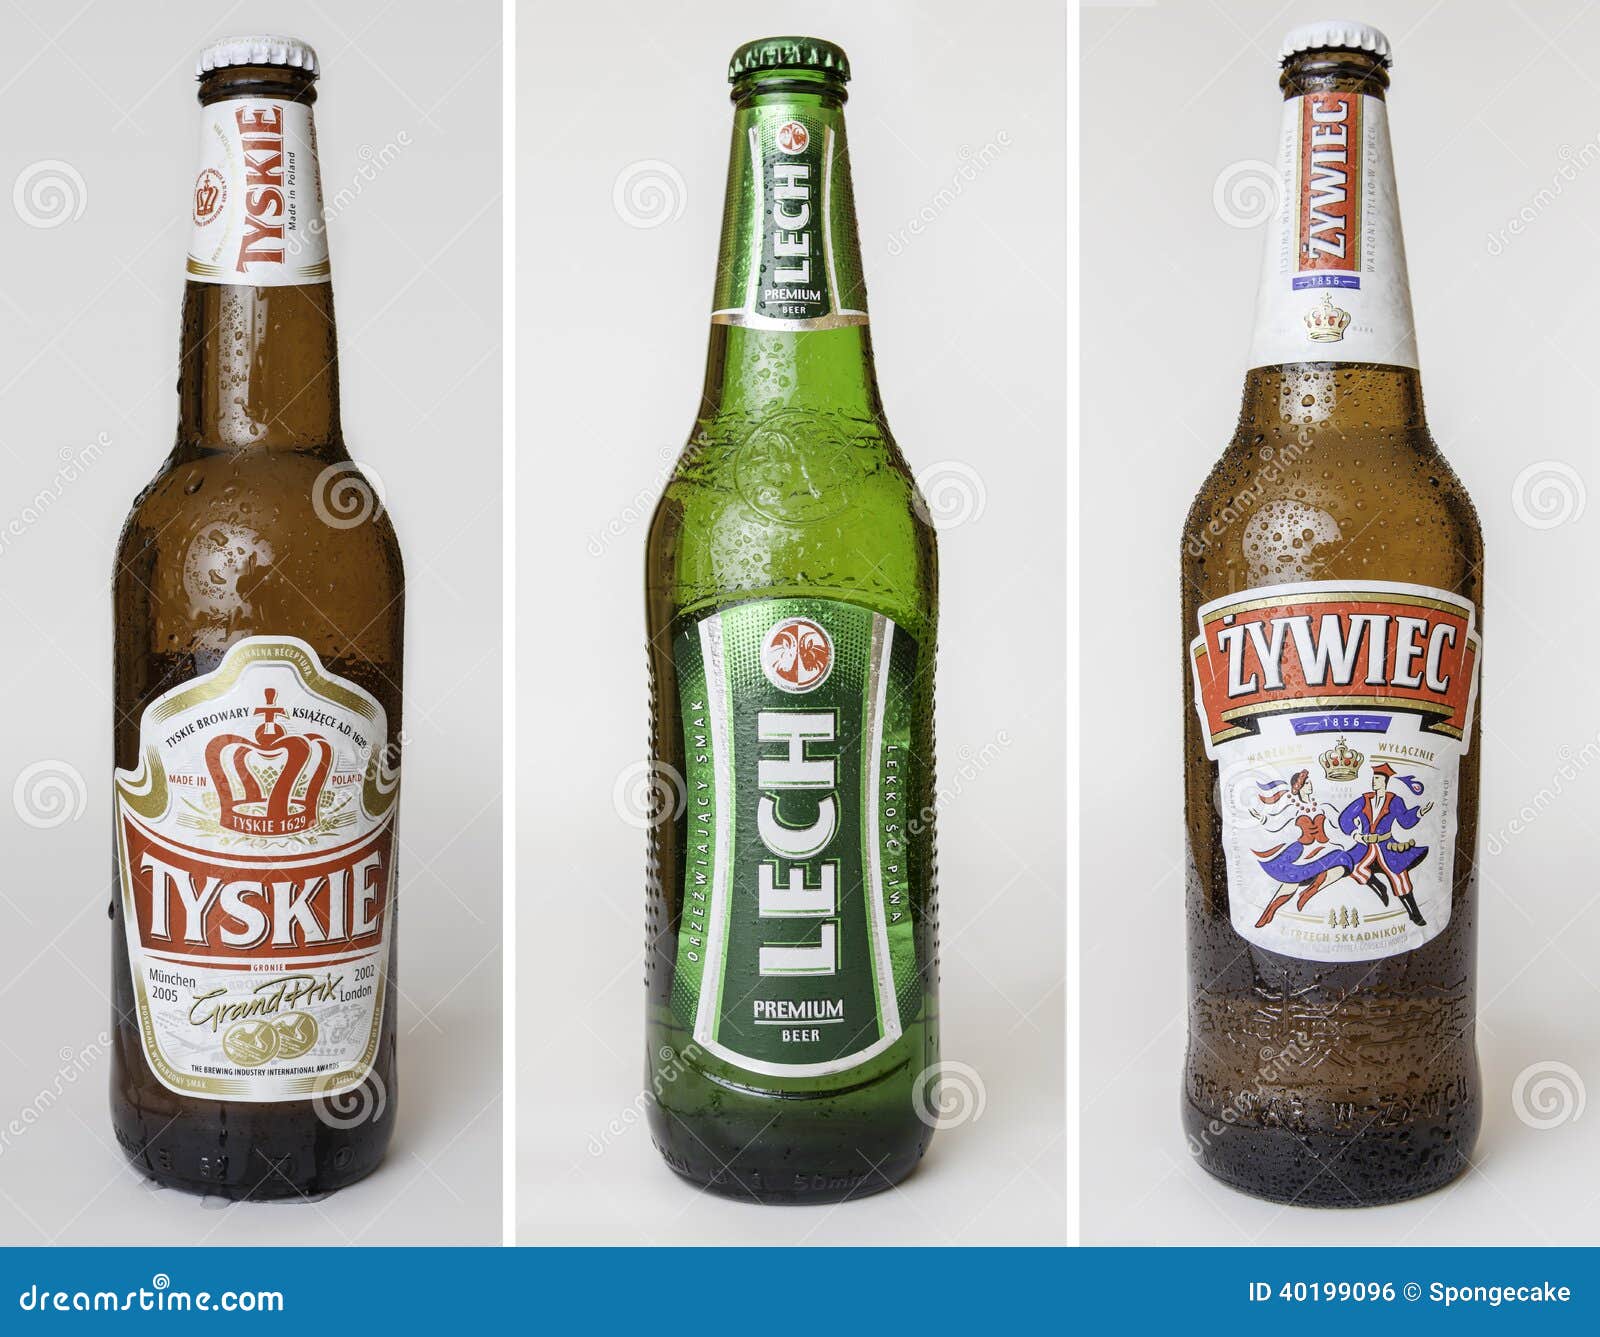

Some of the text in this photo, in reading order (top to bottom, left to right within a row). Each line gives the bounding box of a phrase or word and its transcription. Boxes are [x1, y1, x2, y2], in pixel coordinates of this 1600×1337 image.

[1303, 100, 1350, 260] ŻYWIEC
[1368, 169, 1376, 177] W
[235, 105, 285, 272] TYSKIE
[288, 152, 297, 231] Made in Poland
[773, 163, 813, 284] LECH
[1367, 221, 1376, 272] WARZONY
[1311, 277, 1339, 286] 1856
[764, 288, 821, 301] PREMIUM
[782, 306, 806, 315] BEER
[1216, 614, 1458, 699] ŻYWIEC
[165, 706, 367, 749] TYSKIE BROWARY KSIĄŻĘCE A.D. 1629
[1323, 717, 1360, 728] 1856
[1378, 742, 1435, 762] WYŁĄCZNIE
[169, 774, 206, 787] MADE IN
[332, 773, 362, 786] POLAND
[232, 815, 306, 832] TYSKIE 1629
[687, 700, 712, 962] ORZEŹWIAJĄCY SMAK
[757, 707, 841, 976] LECH
[140, 851, 382, 949] TYSKIE
[887, 865, 902, 922] PIWA
[1335, 923, 1407, 943] SKŁADNIKÓW
[253, 963, 285, 973] GRONIE
[354, 964, 375, 981] 2002
[149, 968, 196, 989] München
[152, 986, 178, 1003] 2005
[189, 982, 287, 1032] Grand
[254, 973, 344, 1009] Prix
[340, 985, 372, 1002] London
[753, 1000, 843, 1018] PREMIUM
[782, 1029, 820, 1042] BEER
[191, 1062, 339, 1077] THE BREWING INDUSTRY INTERNATIONAL AWARDS
